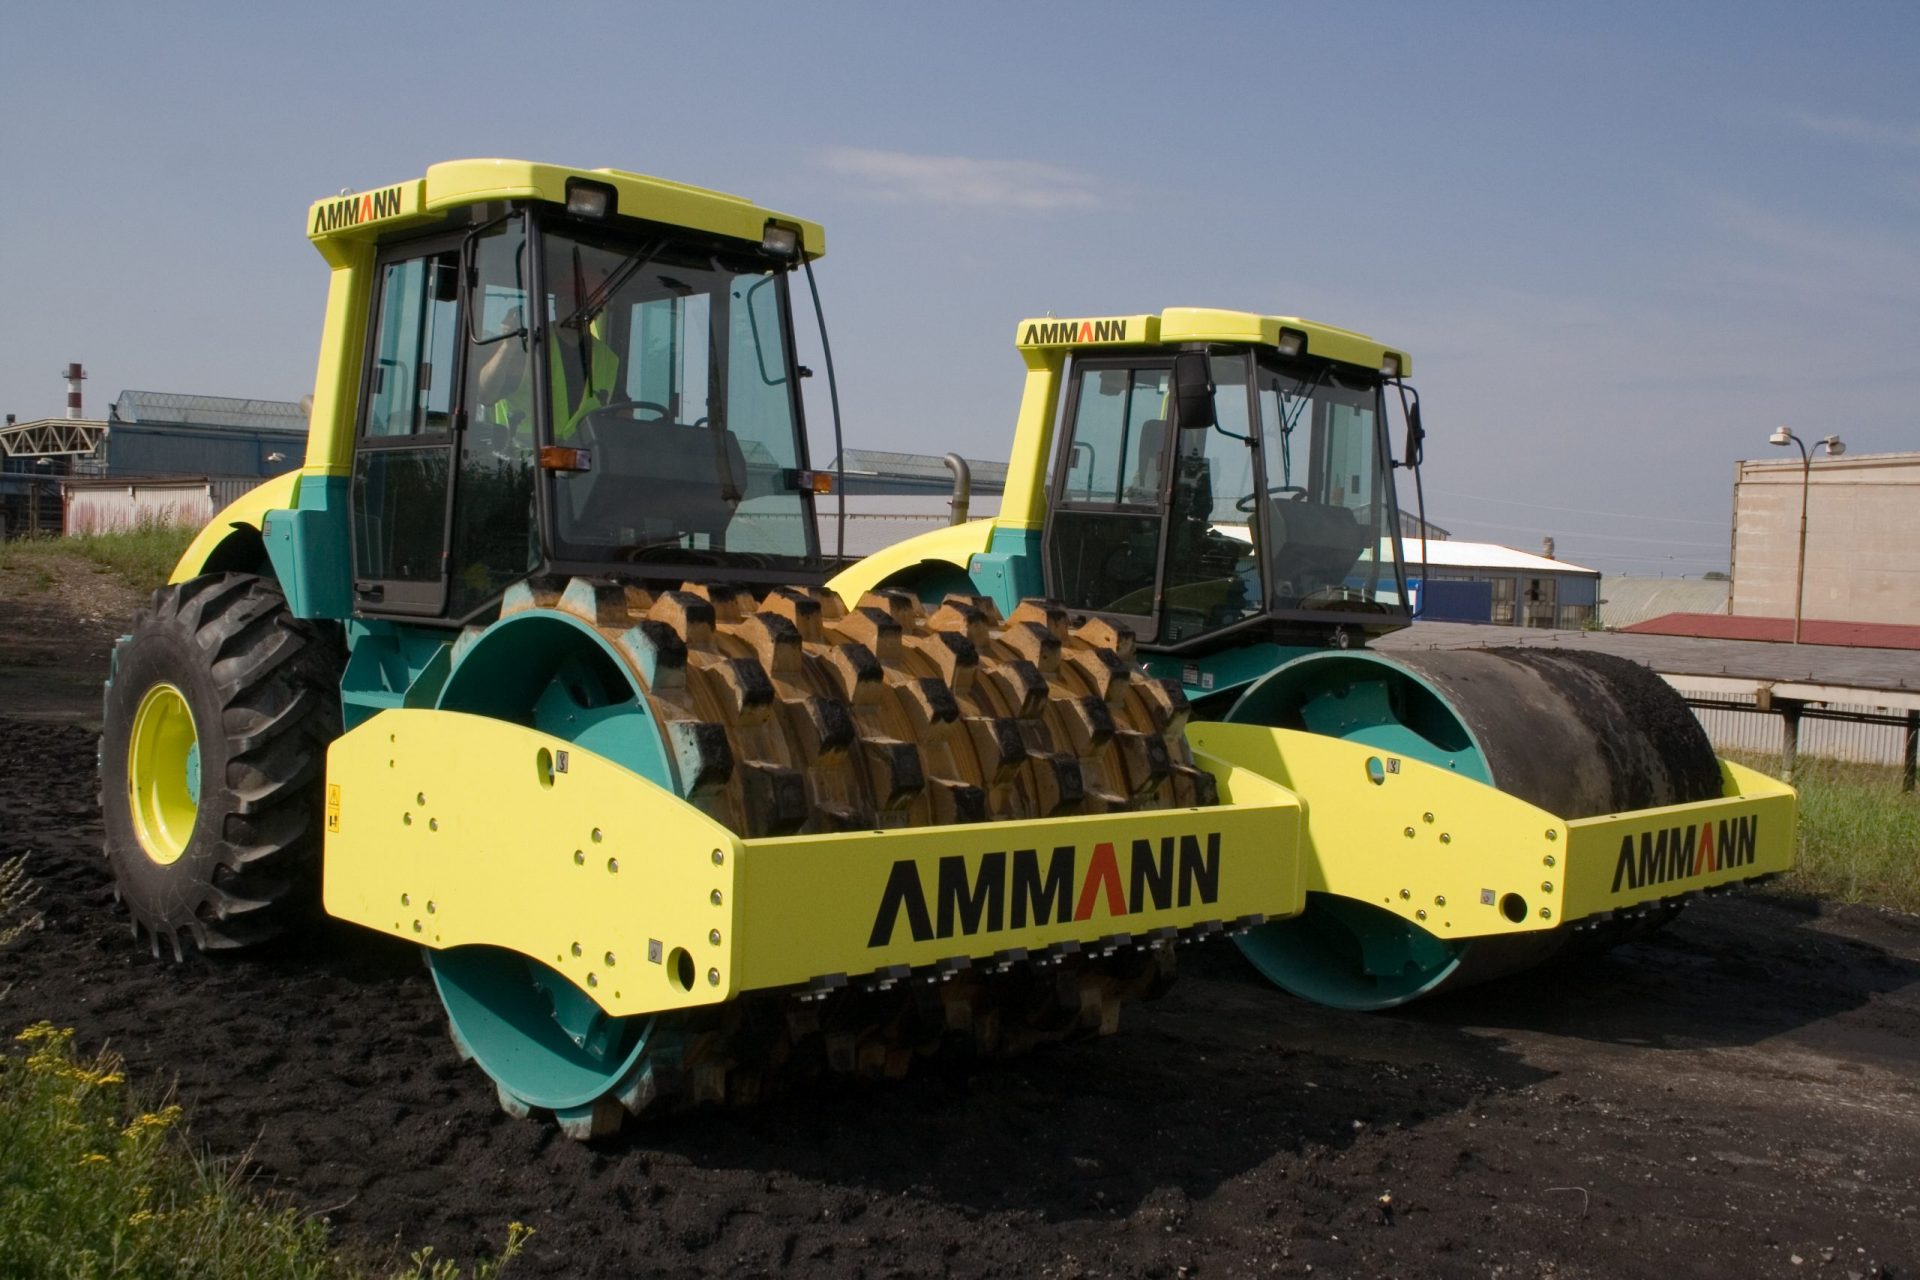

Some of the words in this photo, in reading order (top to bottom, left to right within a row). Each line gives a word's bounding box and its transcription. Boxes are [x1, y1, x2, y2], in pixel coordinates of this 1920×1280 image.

[314, 187, 402, 234] AMMANN
[1024, 320, 1126, 344] AMMANN
[1611, 815, 1757, 893] AMMANN
[867, 832, 1221, 948] AMMANN
